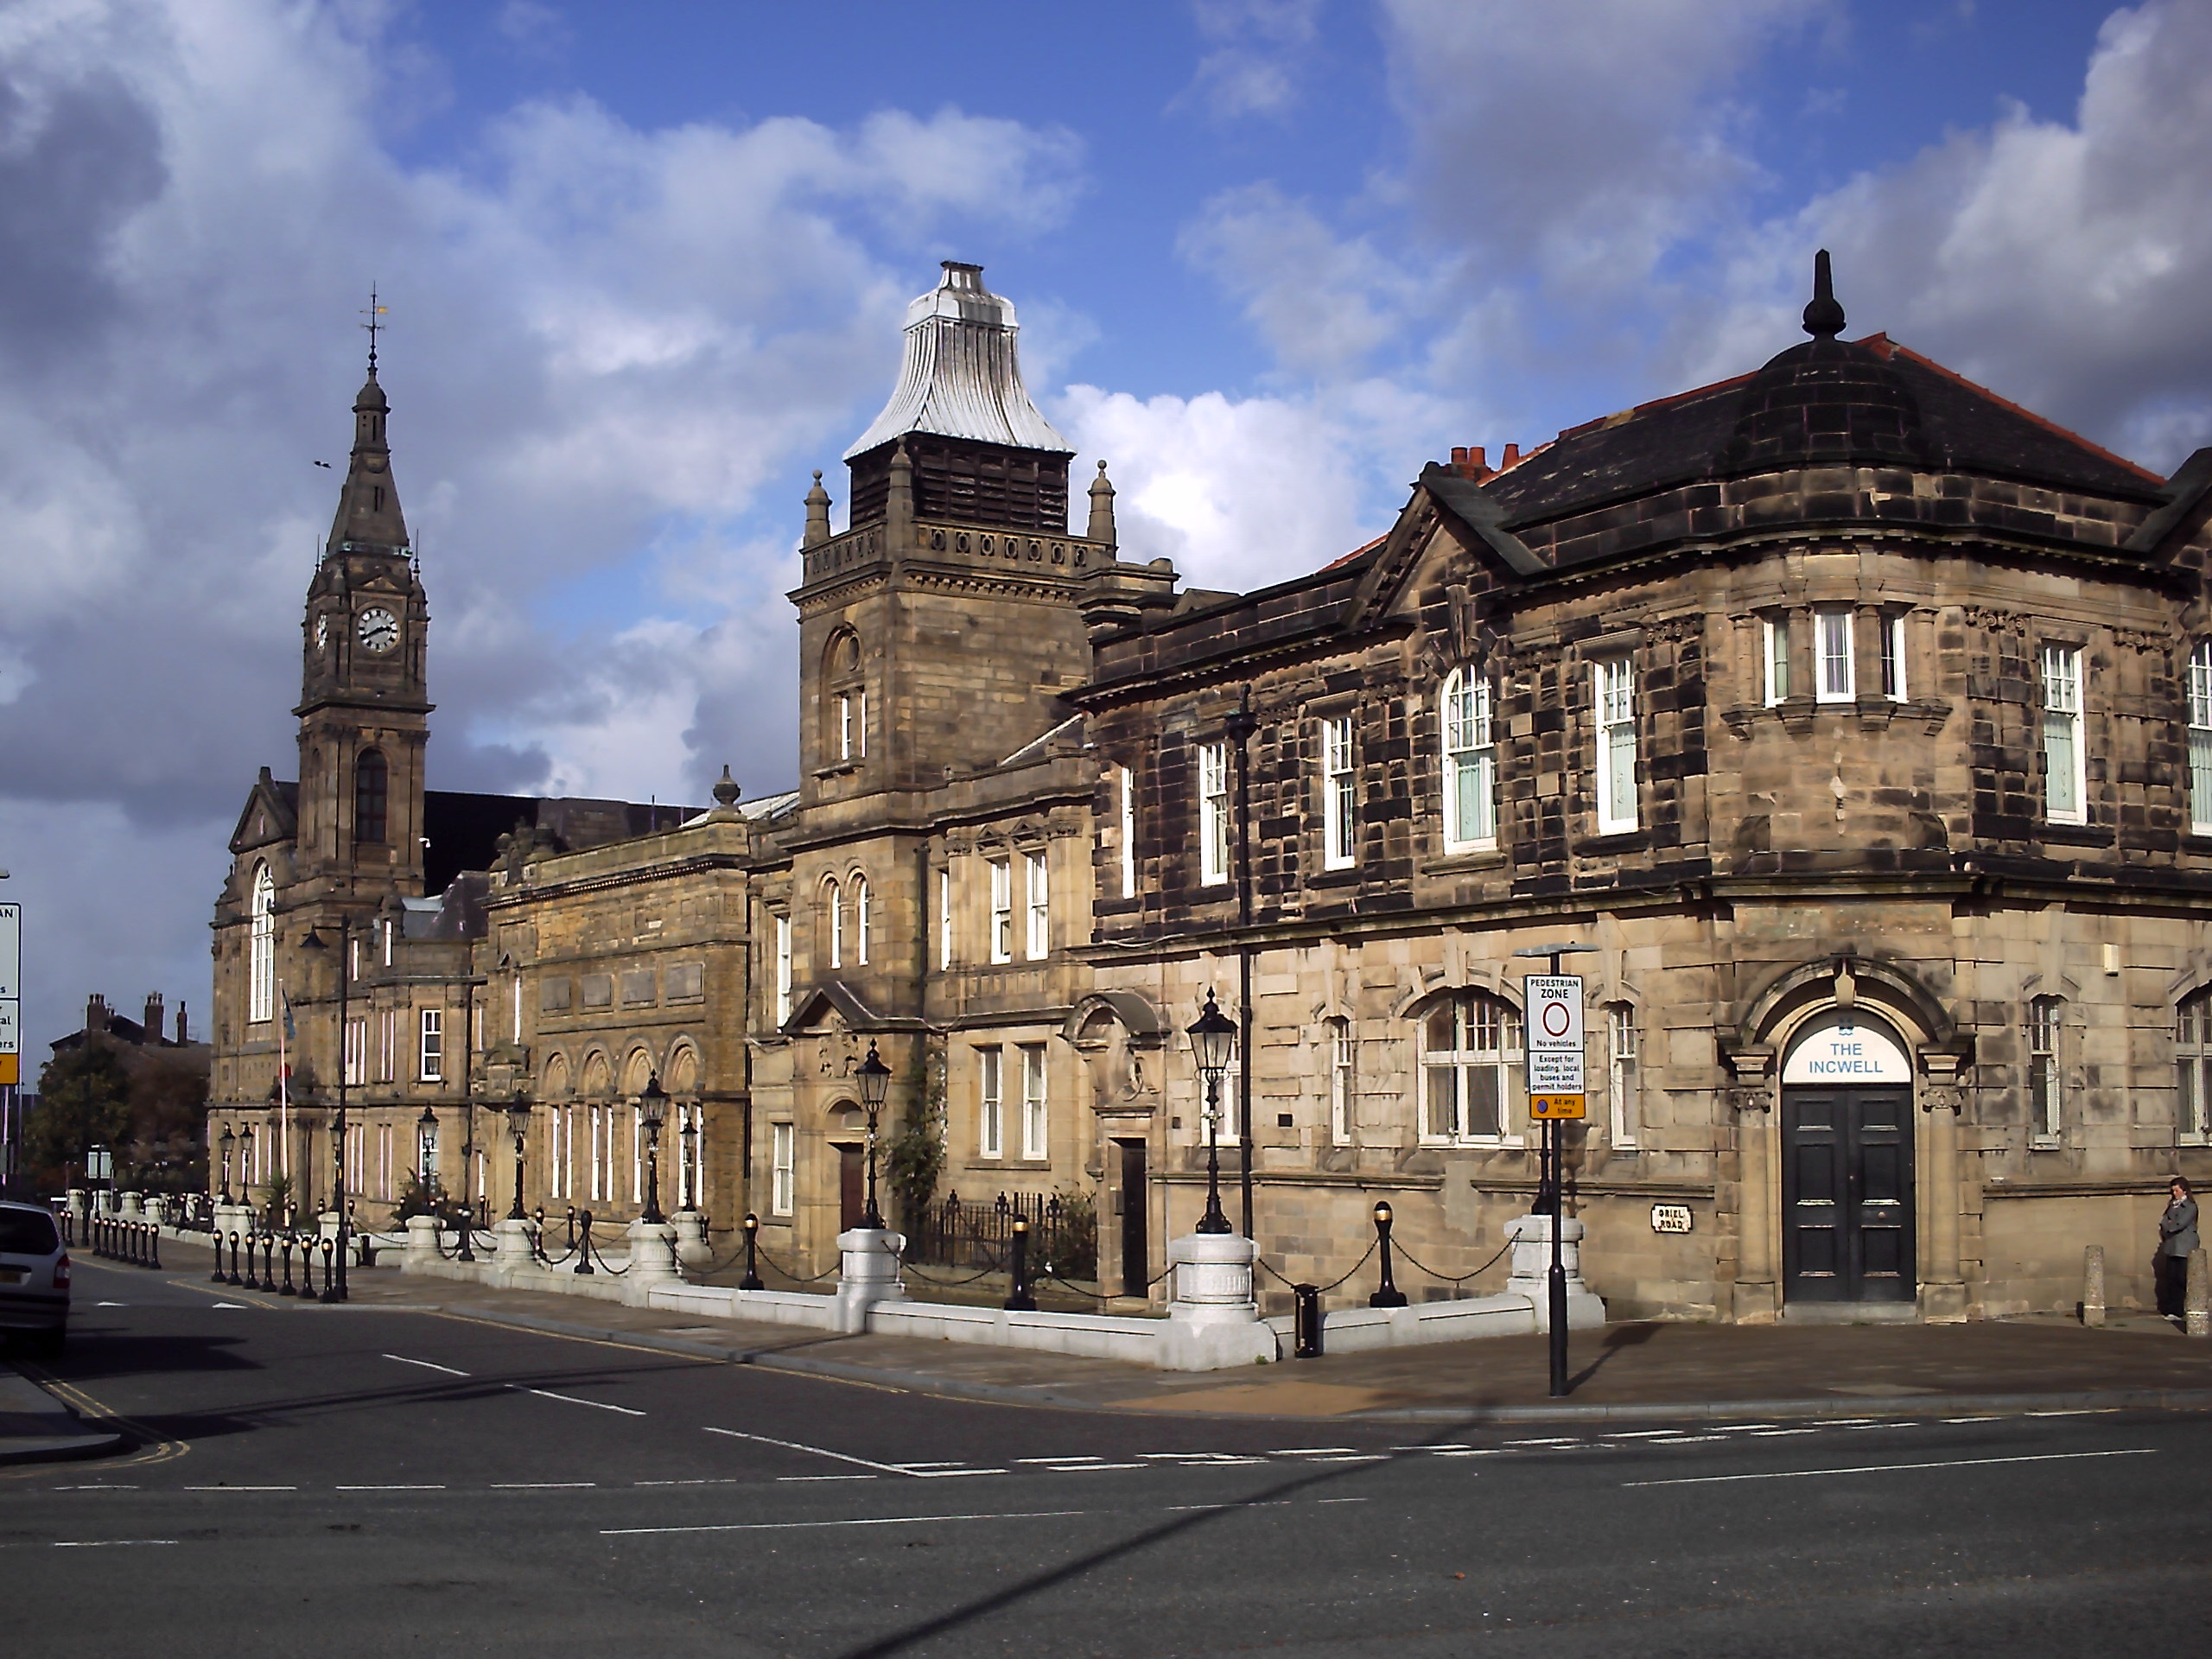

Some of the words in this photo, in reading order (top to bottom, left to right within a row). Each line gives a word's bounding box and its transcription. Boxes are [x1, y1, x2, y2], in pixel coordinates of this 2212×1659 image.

[1541, 988, 1568, 998] ZONE
[1830, 1043, 1862, 1055] THE
[1809, 1061, 1884, 1073] INCWELL
[1659, 1209, 1684, 1218] ORIEL
[1661, 1220, 1683, 1229] ROAD
